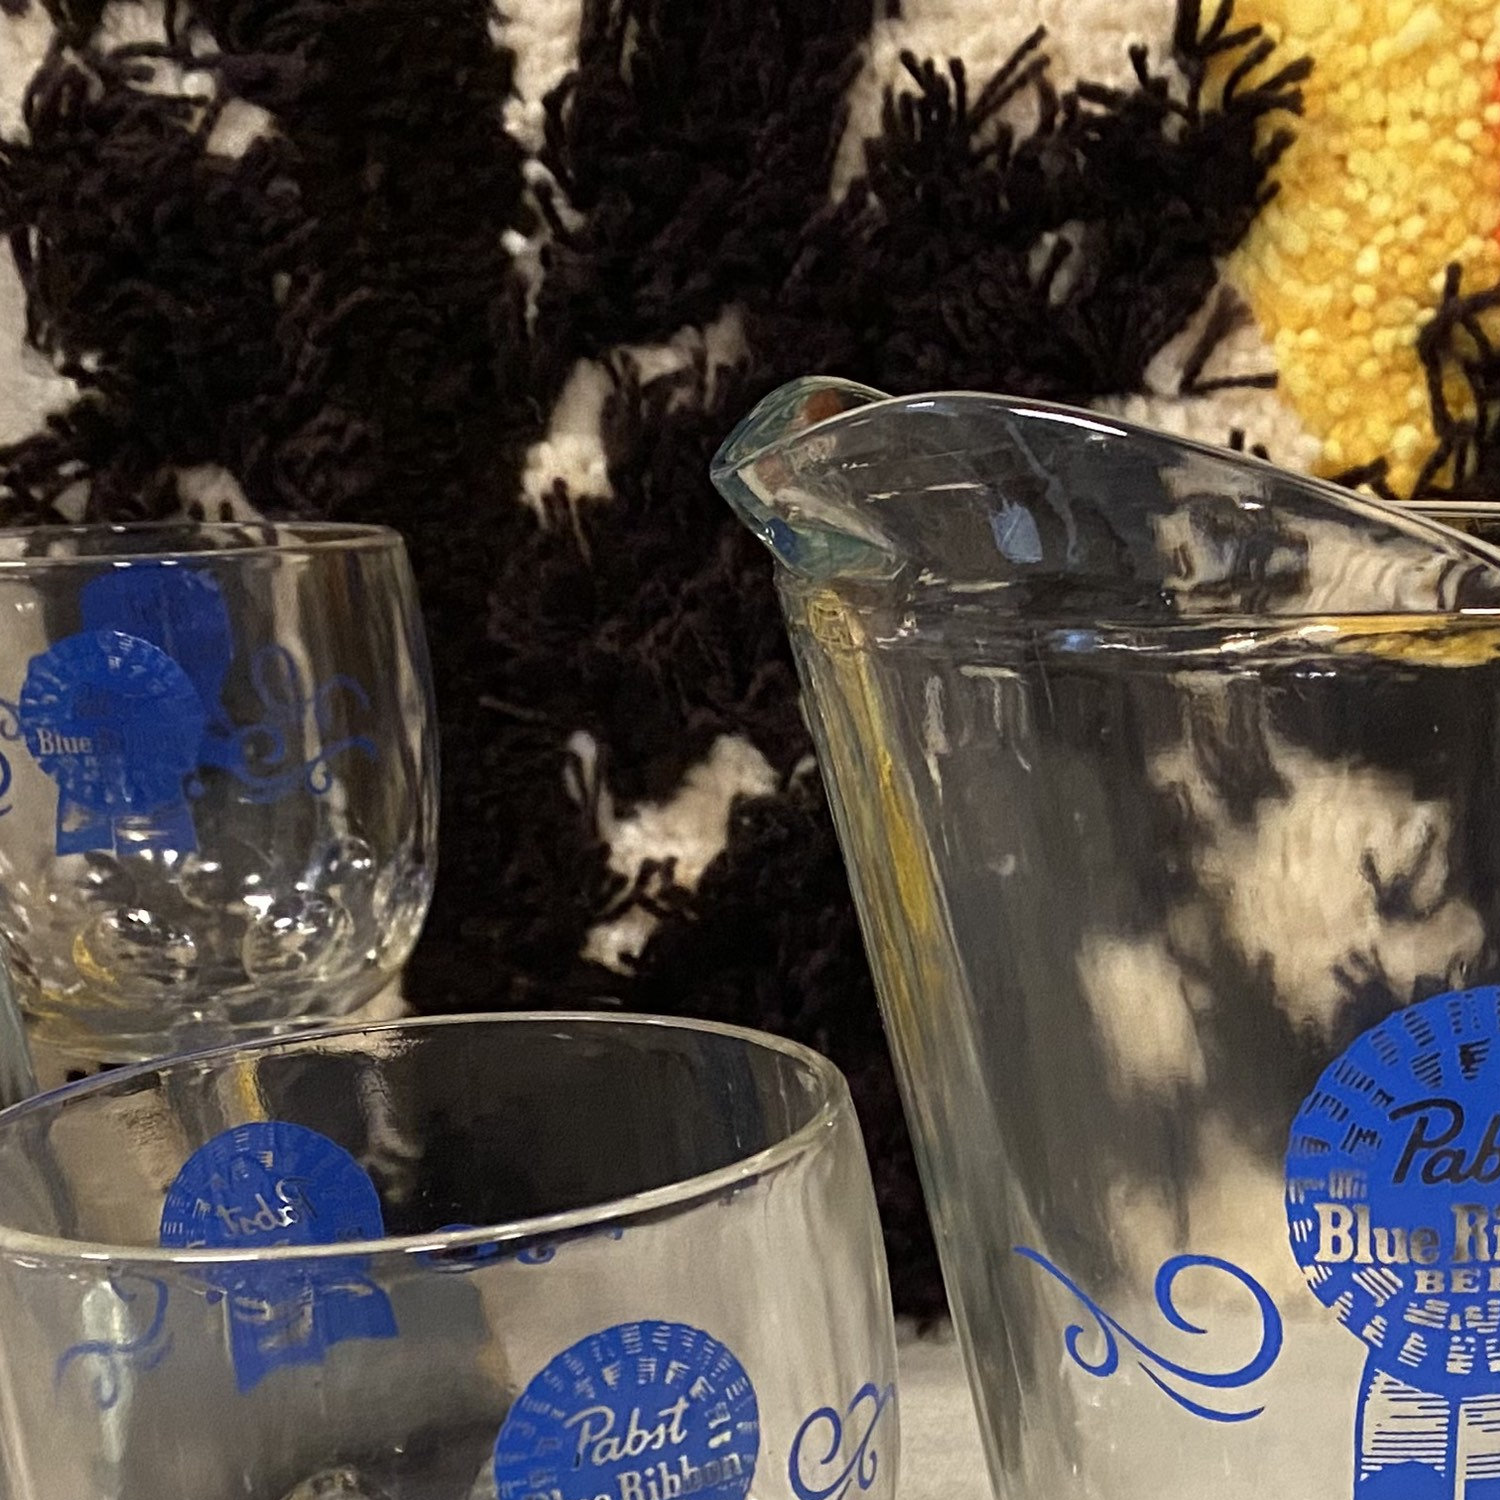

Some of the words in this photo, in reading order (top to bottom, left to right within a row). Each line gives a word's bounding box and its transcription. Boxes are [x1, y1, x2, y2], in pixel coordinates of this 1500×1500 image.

[36, 727, 93, 755] Blue
[1313, 1202, 1441, 1265] Blue
[563, 1396, 691, 1472] Pabst
